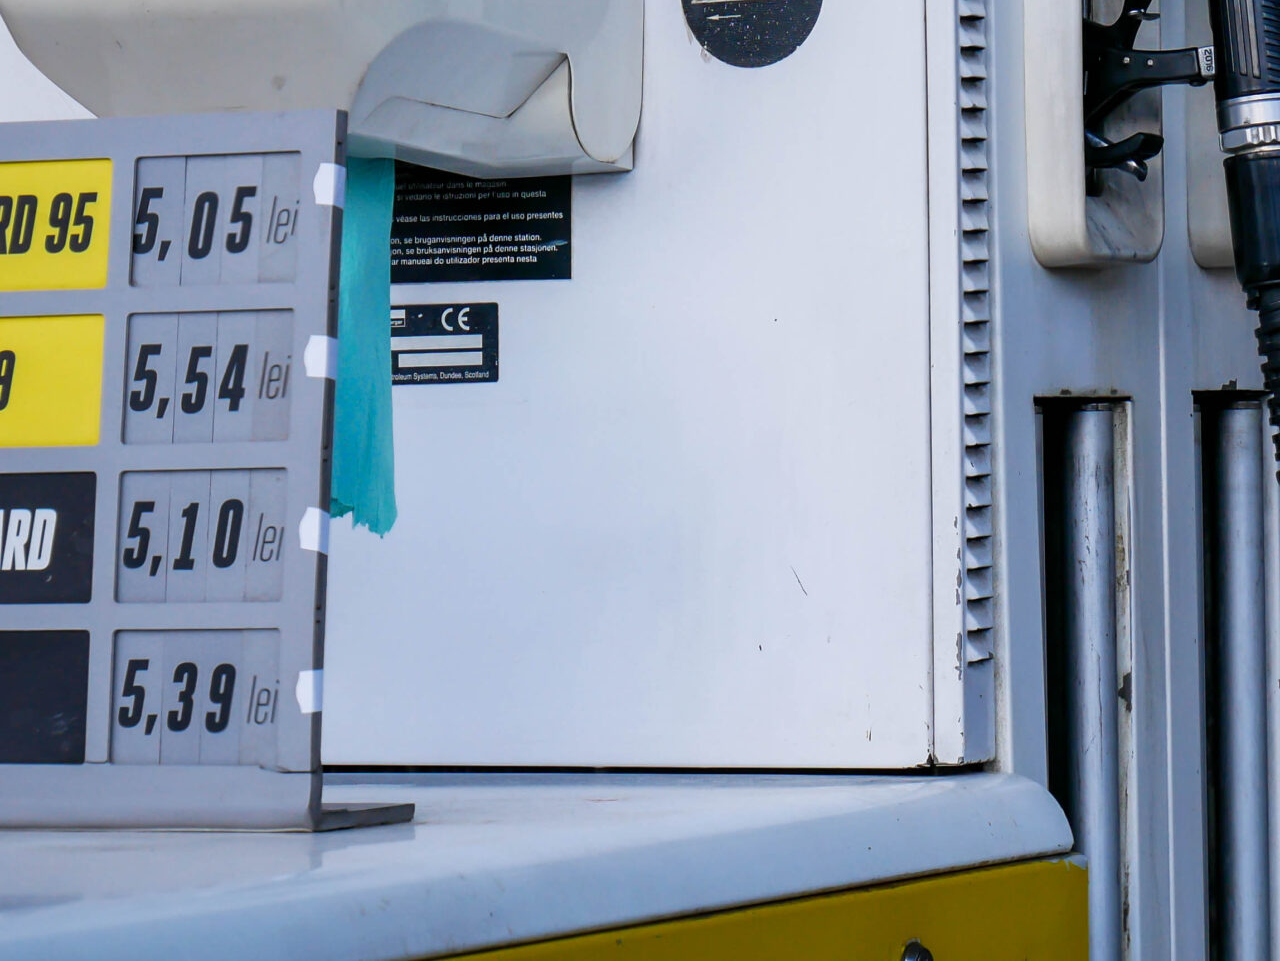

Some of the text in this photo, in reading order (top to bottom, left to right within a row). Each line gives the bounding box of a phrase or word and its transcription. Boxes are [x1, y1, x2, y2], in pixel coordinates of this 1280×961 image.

[521, 190, 547, 199] questa
[45, 192, 98, 254] 95
[132, 186, 300, 261] 5,05 lei
[420, 214, 430, 222] las
[432, 214, 482, 222] instrucciones
[484, 213, 500, 222] para
[503, 212, 509, 220] el
[527, 211, 563, 221] presentes
[414, 236, 476, 245] bruganvisningen
[478, 233, 487, 243] på
[489, 234, 512, 242] denne
[514, 233, 542, 242] station.
[416, 245, 482, 255] bruksanvisningen
[483, 244, 493, 254] på
[495, 245, 518, 253] denne
[520, 243, 558, 253] stasjonen.
[446, 256, 480, 265] utilizador
[516, 254, 537, 263] nesta
[129, 343, 292, 418] 5,54 lei
[413, 371, 438, 381] Systems,
[440, 371, 463, 380] Dundee,
[464, 370, 489, 379] Scotland
[0, 508, 57, 570] RD
[123, 499, 285, 576] 5,10 lei
[118, 659, 280, 735] 5,39 lei
